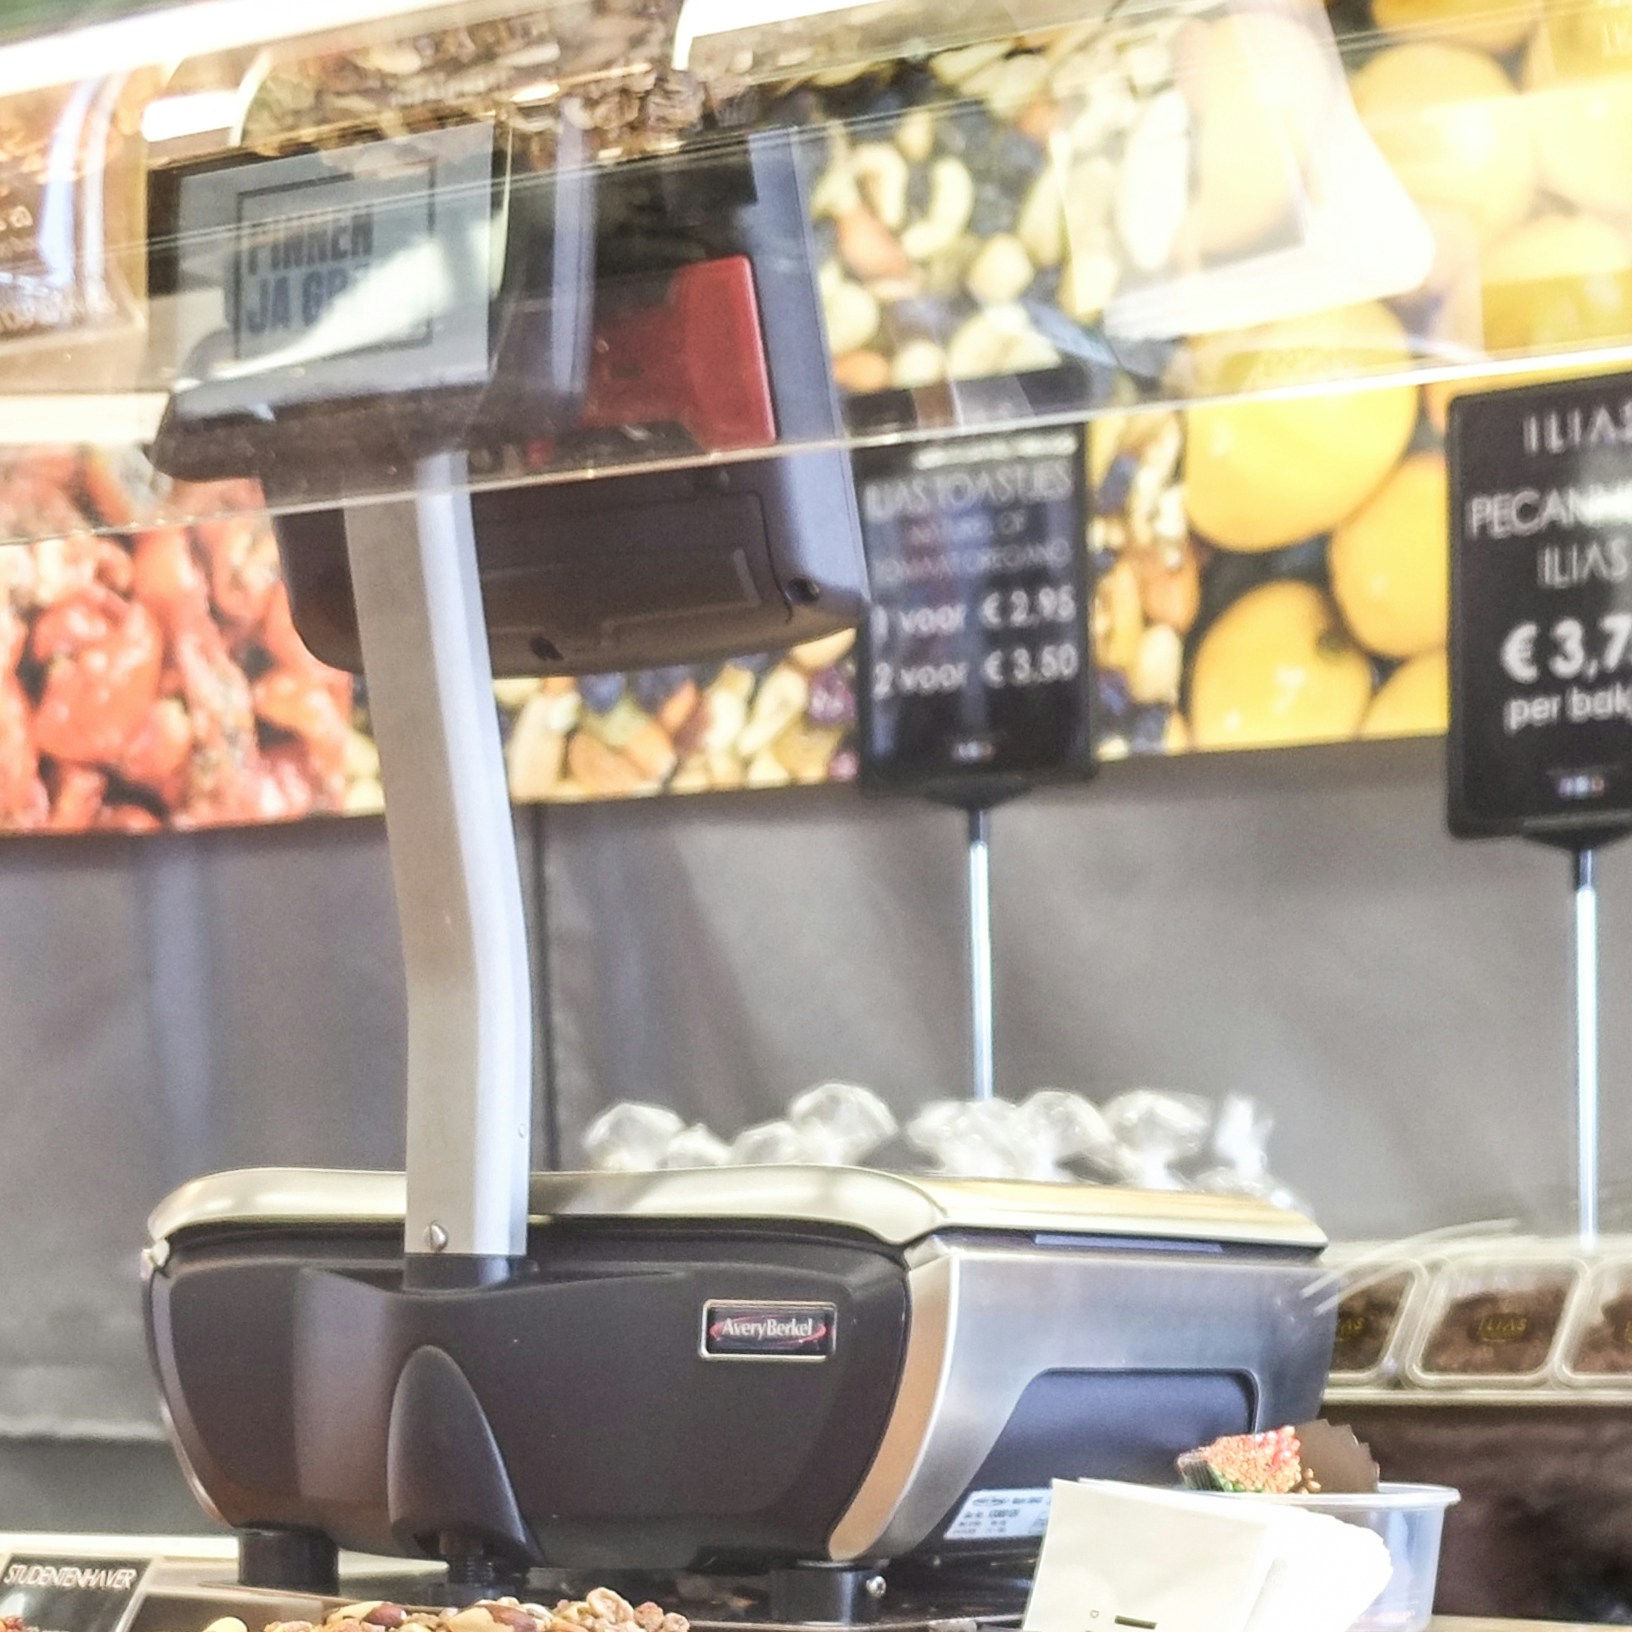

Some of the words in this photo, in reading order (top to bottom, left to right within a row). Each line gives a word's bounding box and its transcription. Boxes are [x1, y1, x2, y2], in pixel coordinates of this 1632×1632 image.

[1537, 538, 1630, 589] ILIAS
[1499, 621, 1540, 684] €
[899, 662, 968, 695] voor
[1503, 693, 1562, 737] per
[3, 1563, 138, 1590] STUDENTENHAVER
